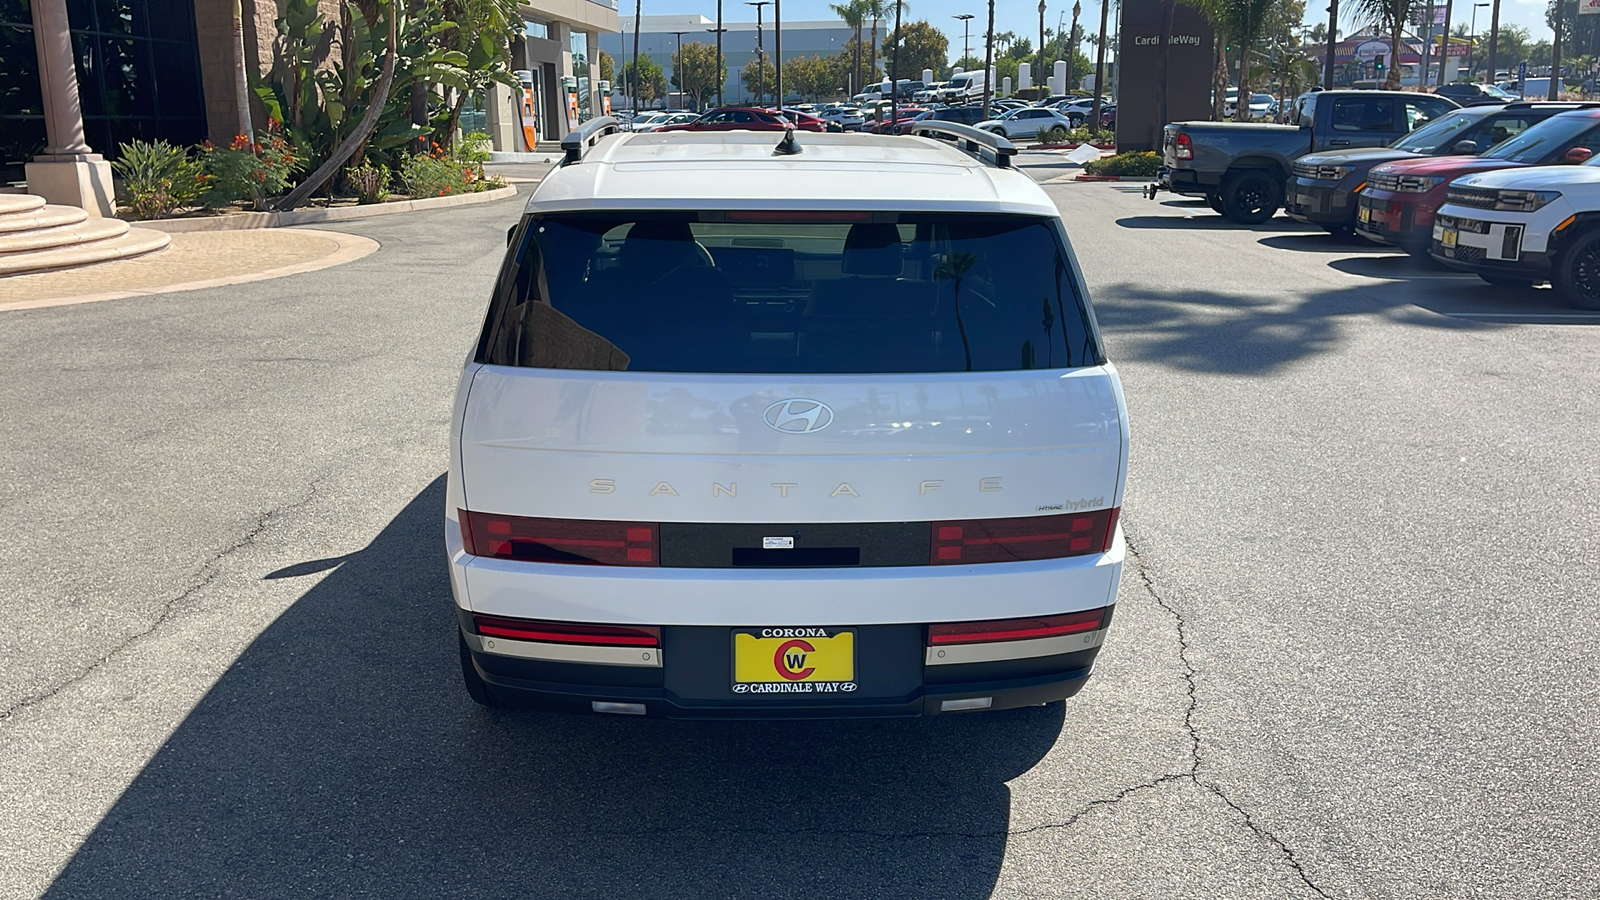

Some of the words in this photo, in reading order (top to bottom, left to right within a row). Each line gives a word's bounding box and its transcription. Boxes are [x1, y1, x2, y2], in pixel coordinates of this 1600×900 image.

[1135, 35, 1200, 46] CardileWay
[588, 478, 860, 498] SANTA
[919, 476, 1003, 495] FE
[1065, 496, 1104, 511] hybrid
[762, 628, 827, 638] CORONA
[750, 683, 812, 693] CARDINALE
[815, 682, 840, 692] WAY
